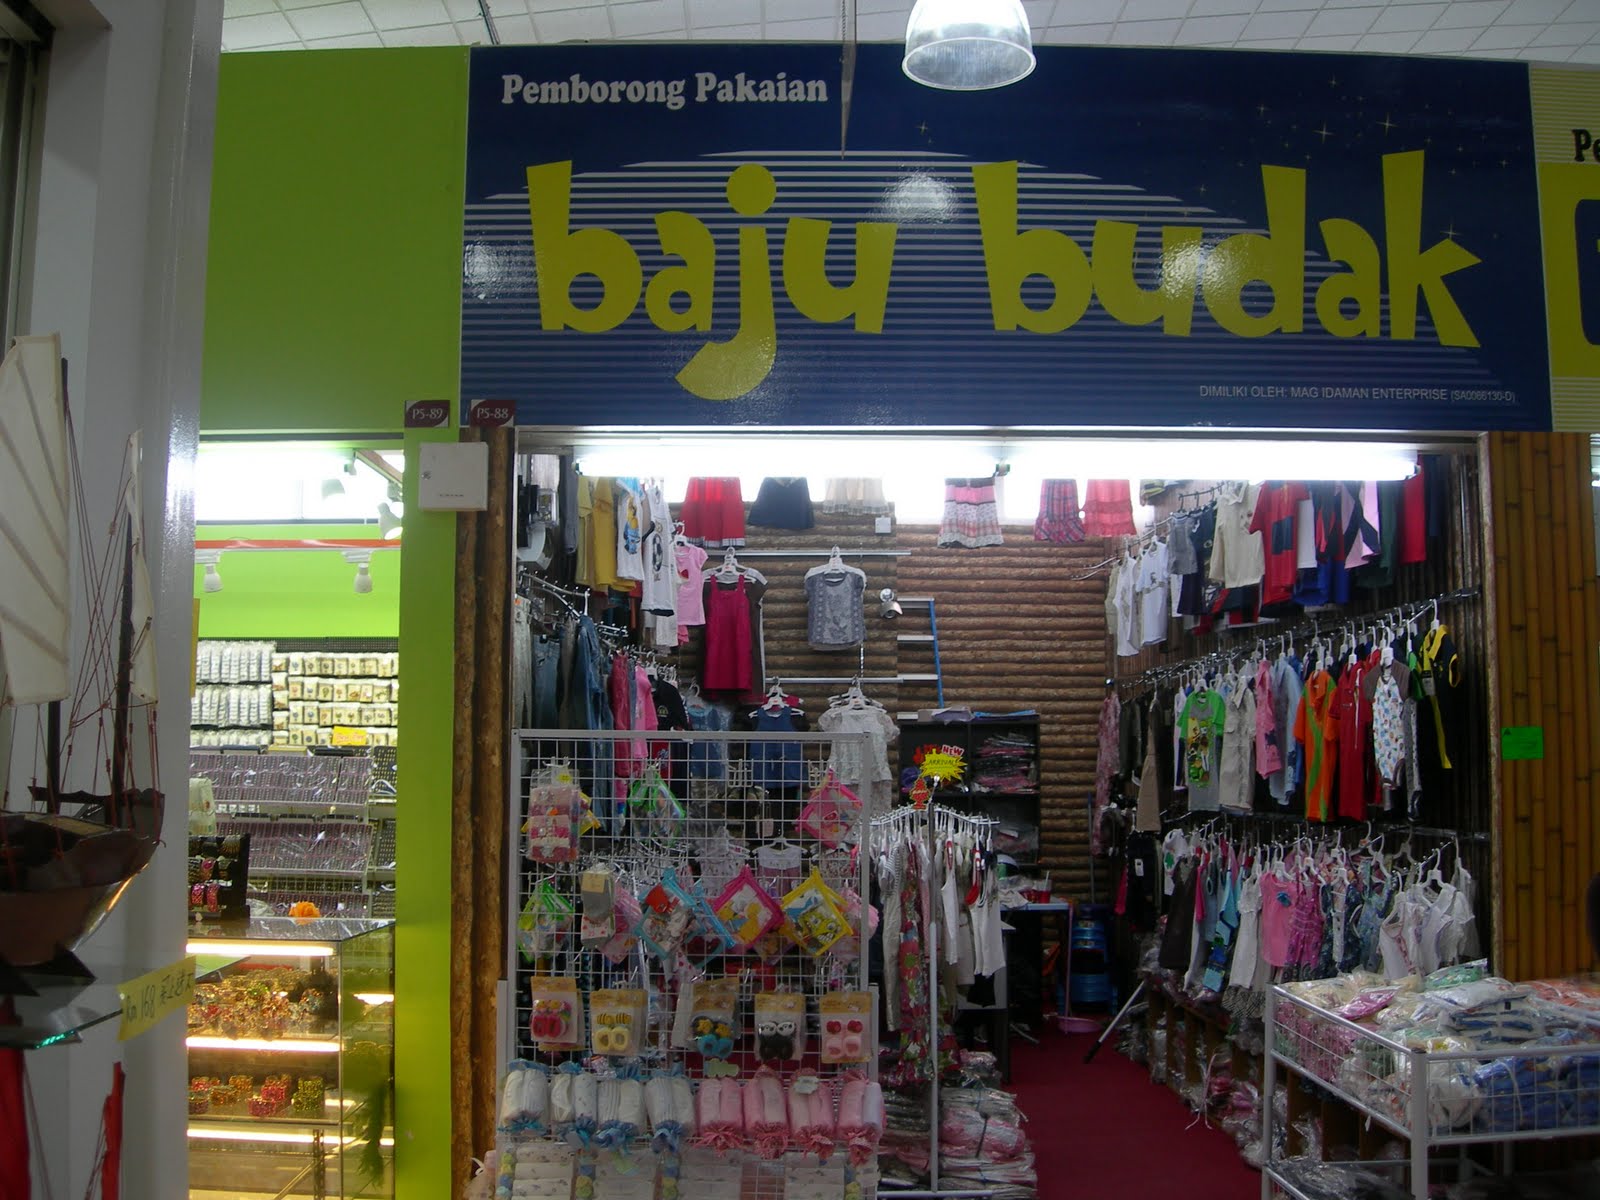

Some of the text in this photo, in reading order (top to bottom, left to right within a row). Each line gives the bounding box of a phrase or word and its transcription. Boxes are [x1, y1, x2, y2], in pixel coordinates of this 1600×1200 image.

[501, 72, 828, 110] Pemborong Pakaian
[526, 160, 898, 401] baju
[972, 150, 1482, 348] budak
[1200, 385, 1248, 397] DIMILIKI
[1251, 386, 1288, 398] OLEH:
[1291, 387, 1319, 398] MAG
[1322, 387, 1369, 399] IDAMAN
[1372, 388, 1448, 400] ENTERPRISE
[412, 408, 443, 420] P5-89
[477, 407, 509, 419] P5-88
[942, 745, 963, 756] NEW
